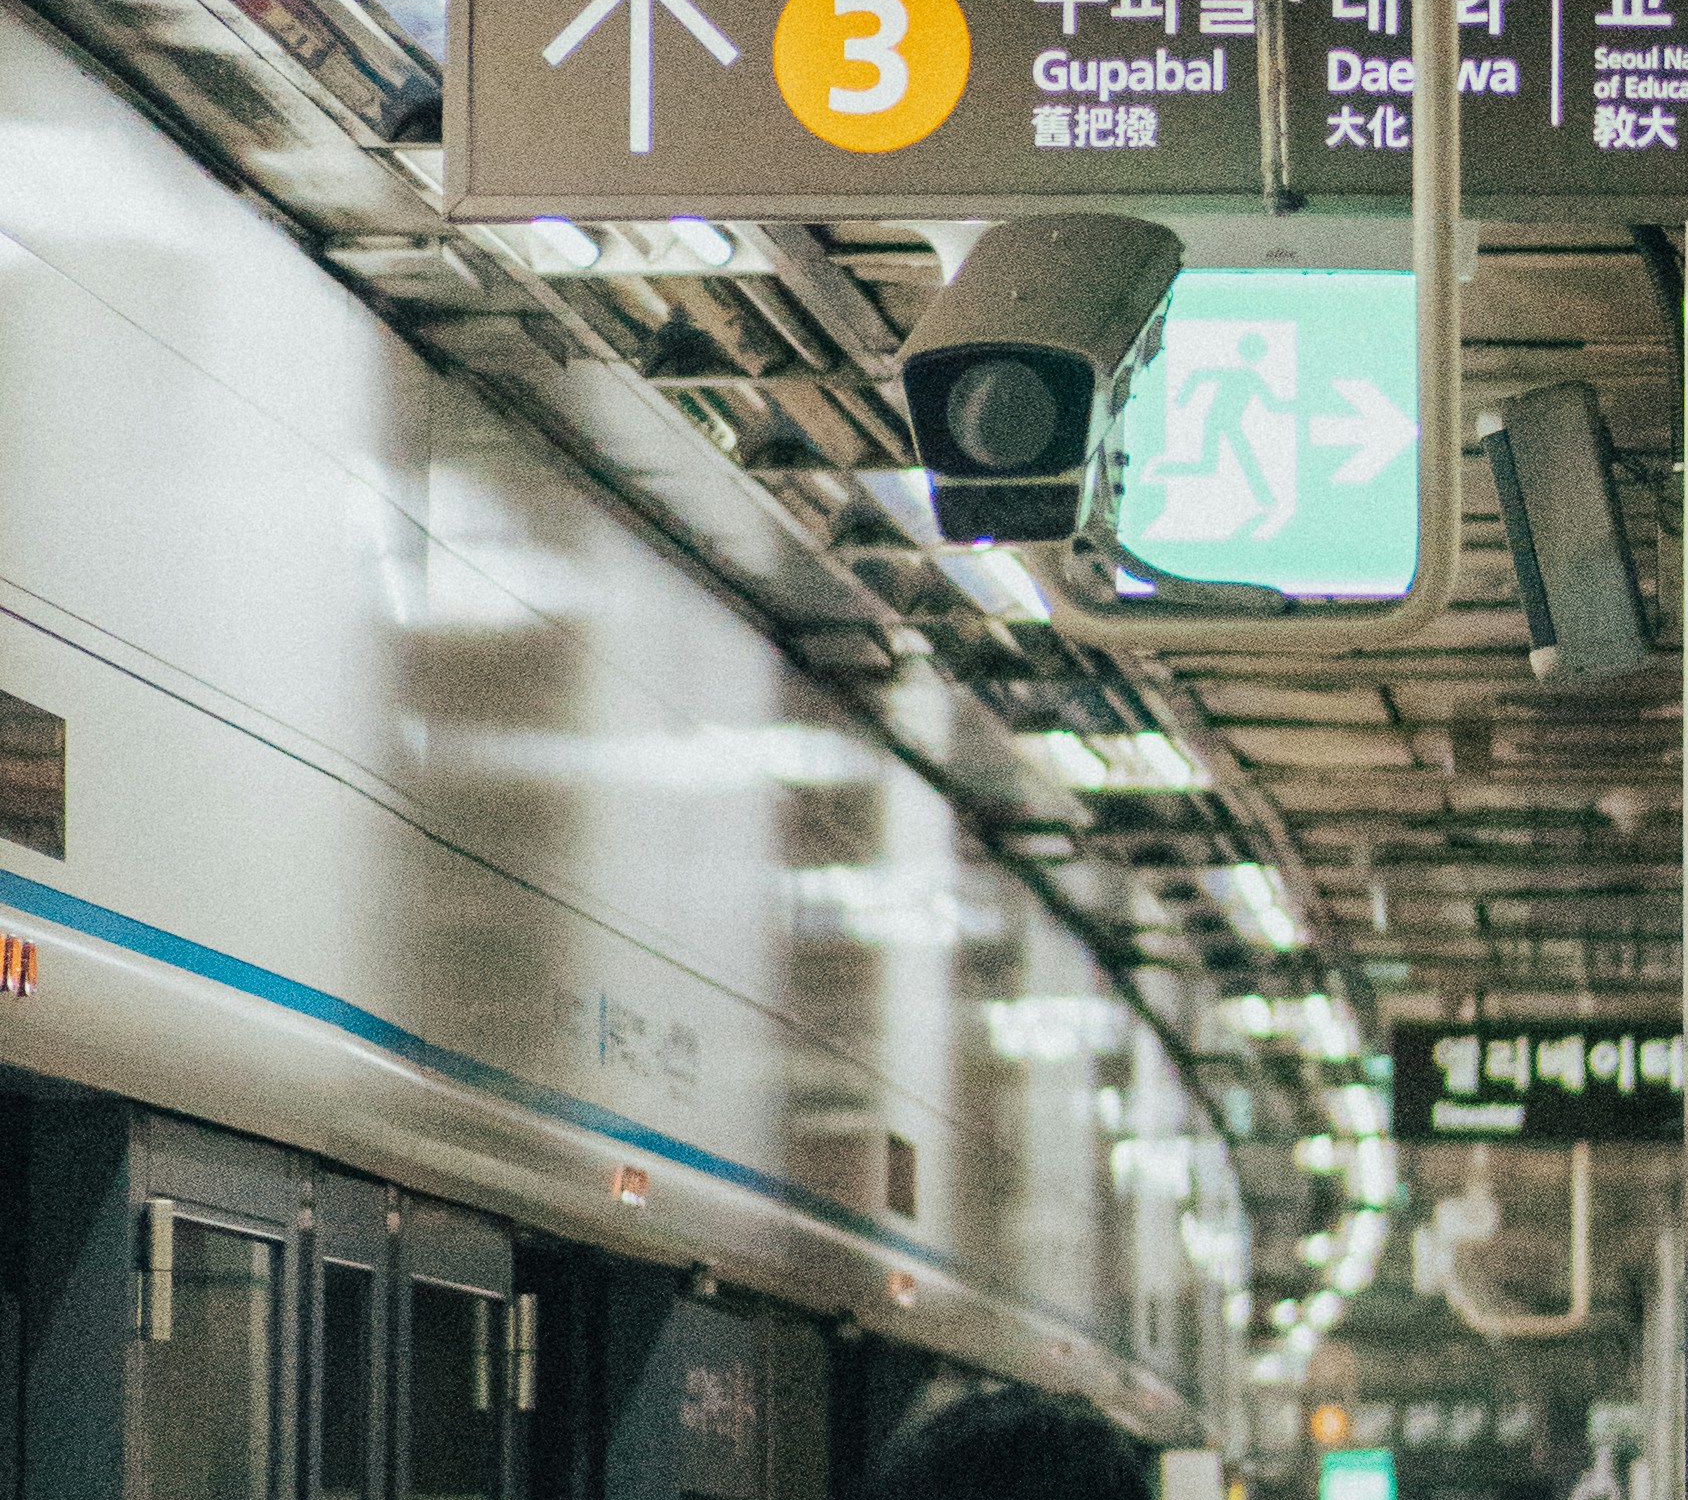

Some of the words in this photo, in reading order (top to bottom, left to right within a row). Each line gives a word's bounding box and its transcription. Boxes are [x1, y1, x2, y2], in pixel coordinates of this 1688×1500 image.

[1032, 47, 1225, 102] Gupabal
[1327, 49, 1519, 94] Daewa
[1594, 45, 1659, 71] Seoul
[1593, 74, 1621, 100] of
[1325, 105, 1410, 149] 大化
